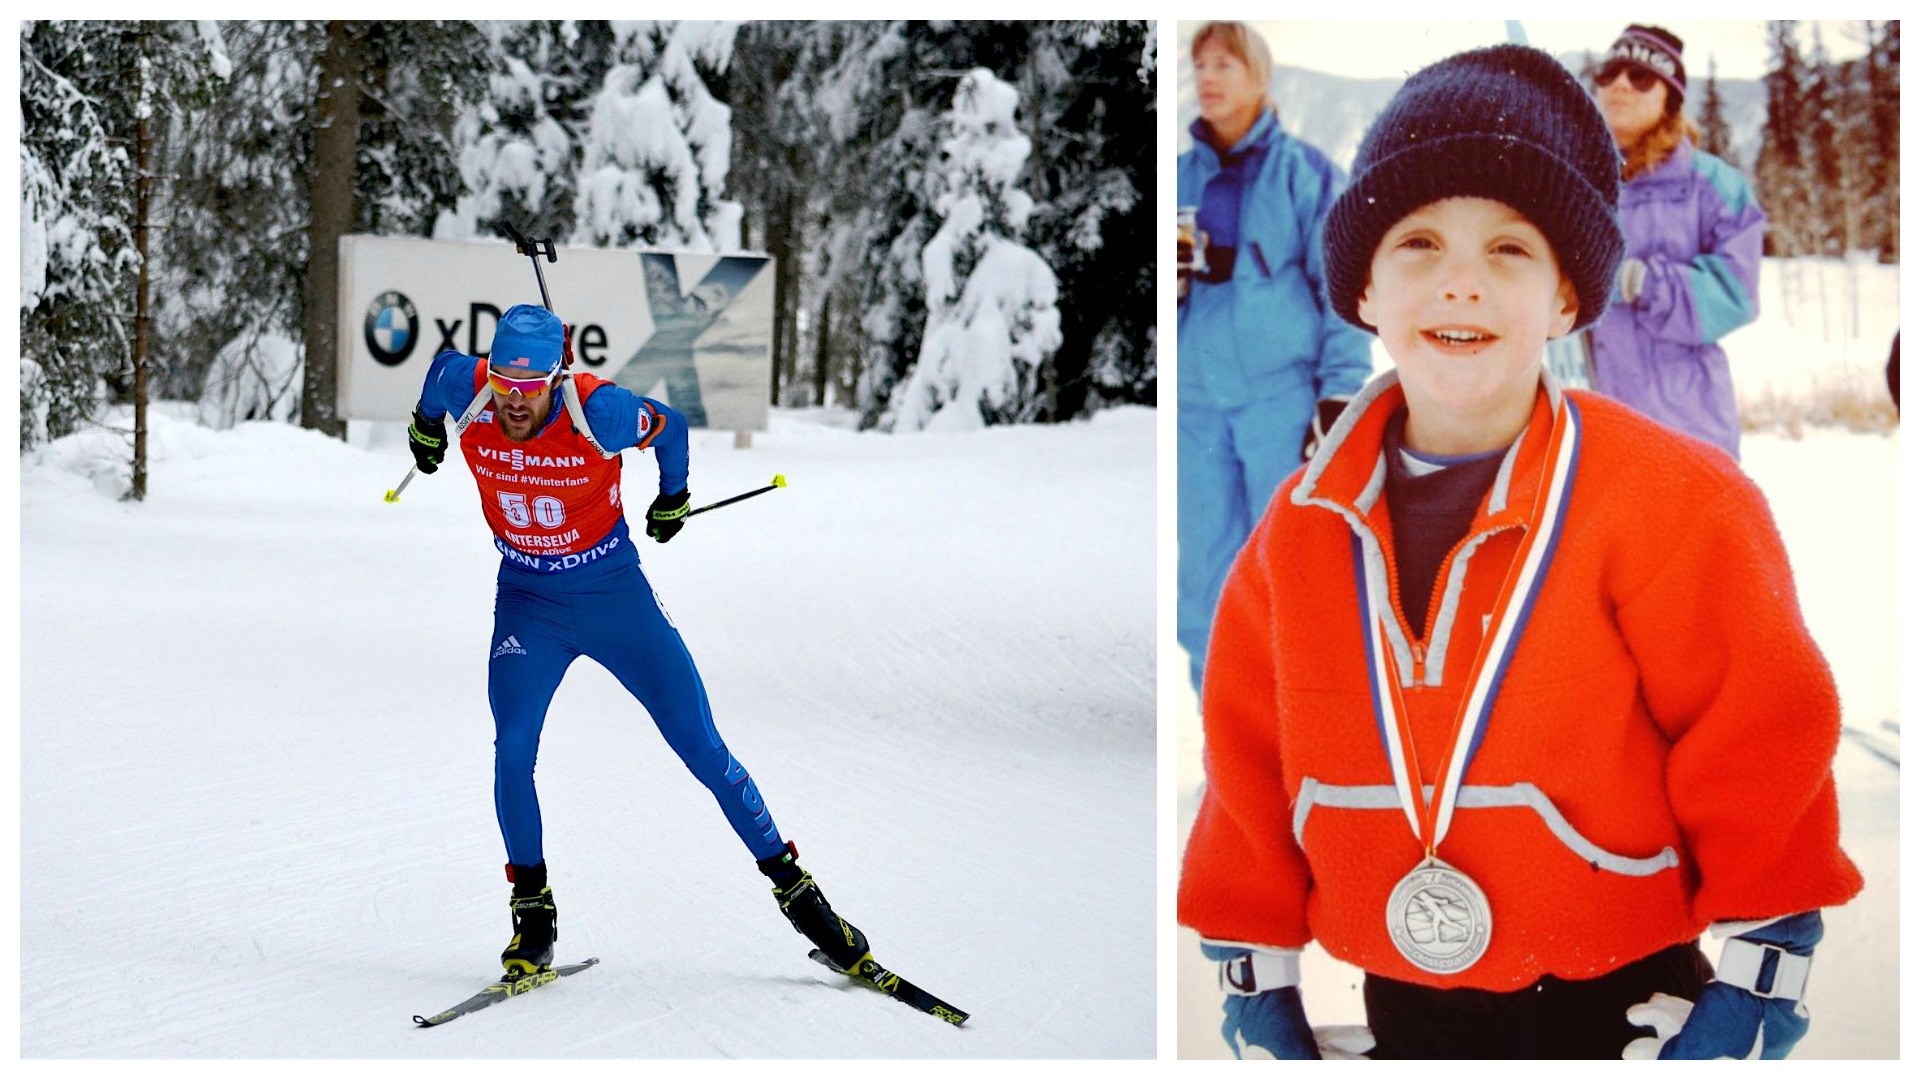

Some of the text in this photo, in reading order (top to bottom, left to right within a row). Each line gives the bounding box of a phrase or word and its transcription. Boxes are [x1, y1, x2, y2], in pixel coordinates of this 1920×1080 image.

[477, 445, 586, 471] VIESSMANN
[475, 463, 590, 487] Wir sind #Winterfans
[496, 490, 566, 530] 50
[504, 528, 581, 548] ANTERSELVA
[492, 646, 527, 659] adidas
[514, 970, 558, 995] FISCHER
[929, 1004, 964, 1025] FISCHER
